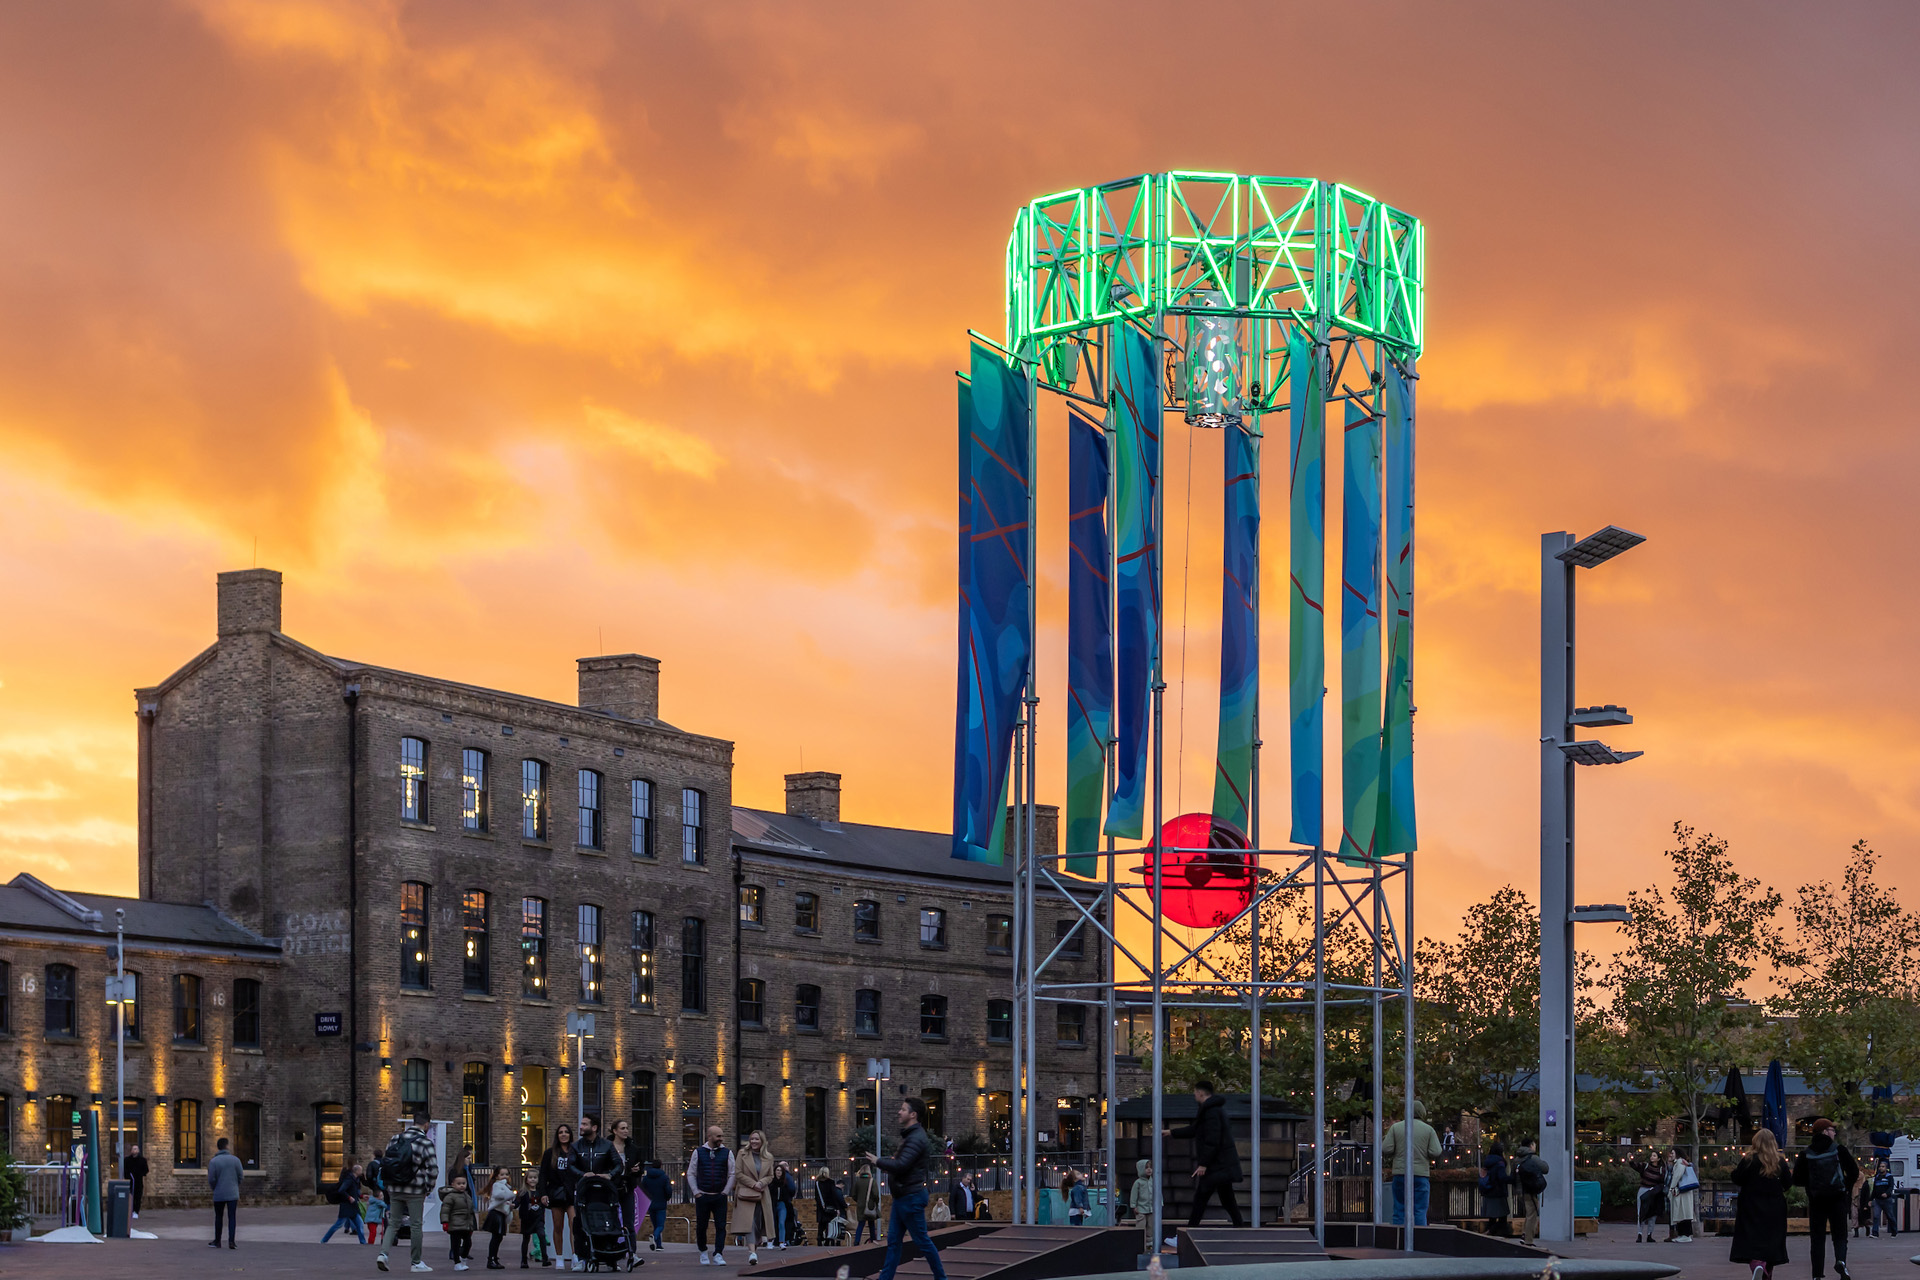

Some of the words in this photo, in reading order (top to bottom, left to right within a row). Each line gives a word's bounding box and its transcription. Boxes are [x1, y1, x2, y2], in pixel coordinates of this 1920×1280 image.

[748, 961, 759, 974] 19
[22, 978, 36, 992] 15
[863, 975, 874, 986] 20
[930, 979, 939, 991] 21
[213, 993, 226, 1006] 16
[215, 1115, 224, 1129] 2
